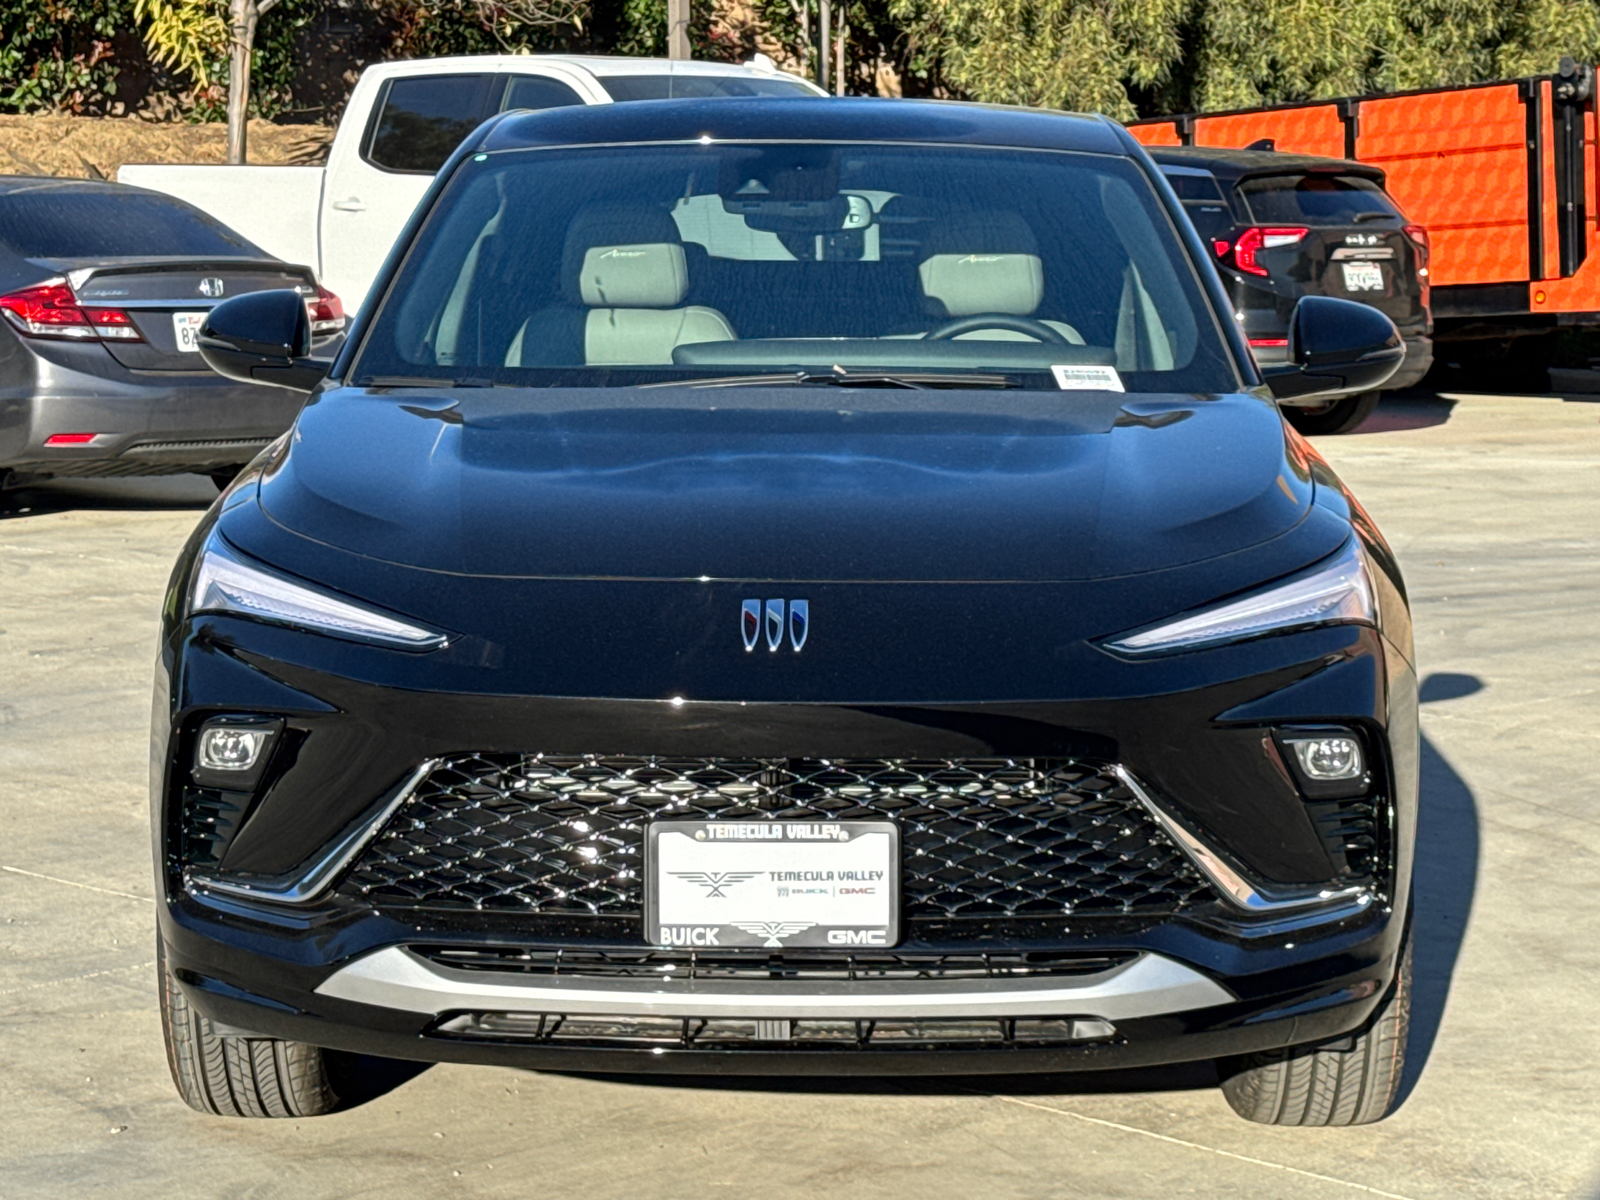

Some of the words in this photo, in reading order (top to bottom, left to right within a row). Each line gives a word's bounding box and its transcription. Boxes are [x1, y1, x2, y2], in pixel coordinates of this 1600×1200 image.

[706, 824, 782, 840] TEMECULA
[787, 824, 840, 840] VALLEY
[769, 871, 835, 882] TEMECULA
[838, 870, 884, 882] VALLEY
[839, 887, 876, 895] GMC
[660, 927, 720, 946] BUICK
[827, 929, 887, 945] GMC
